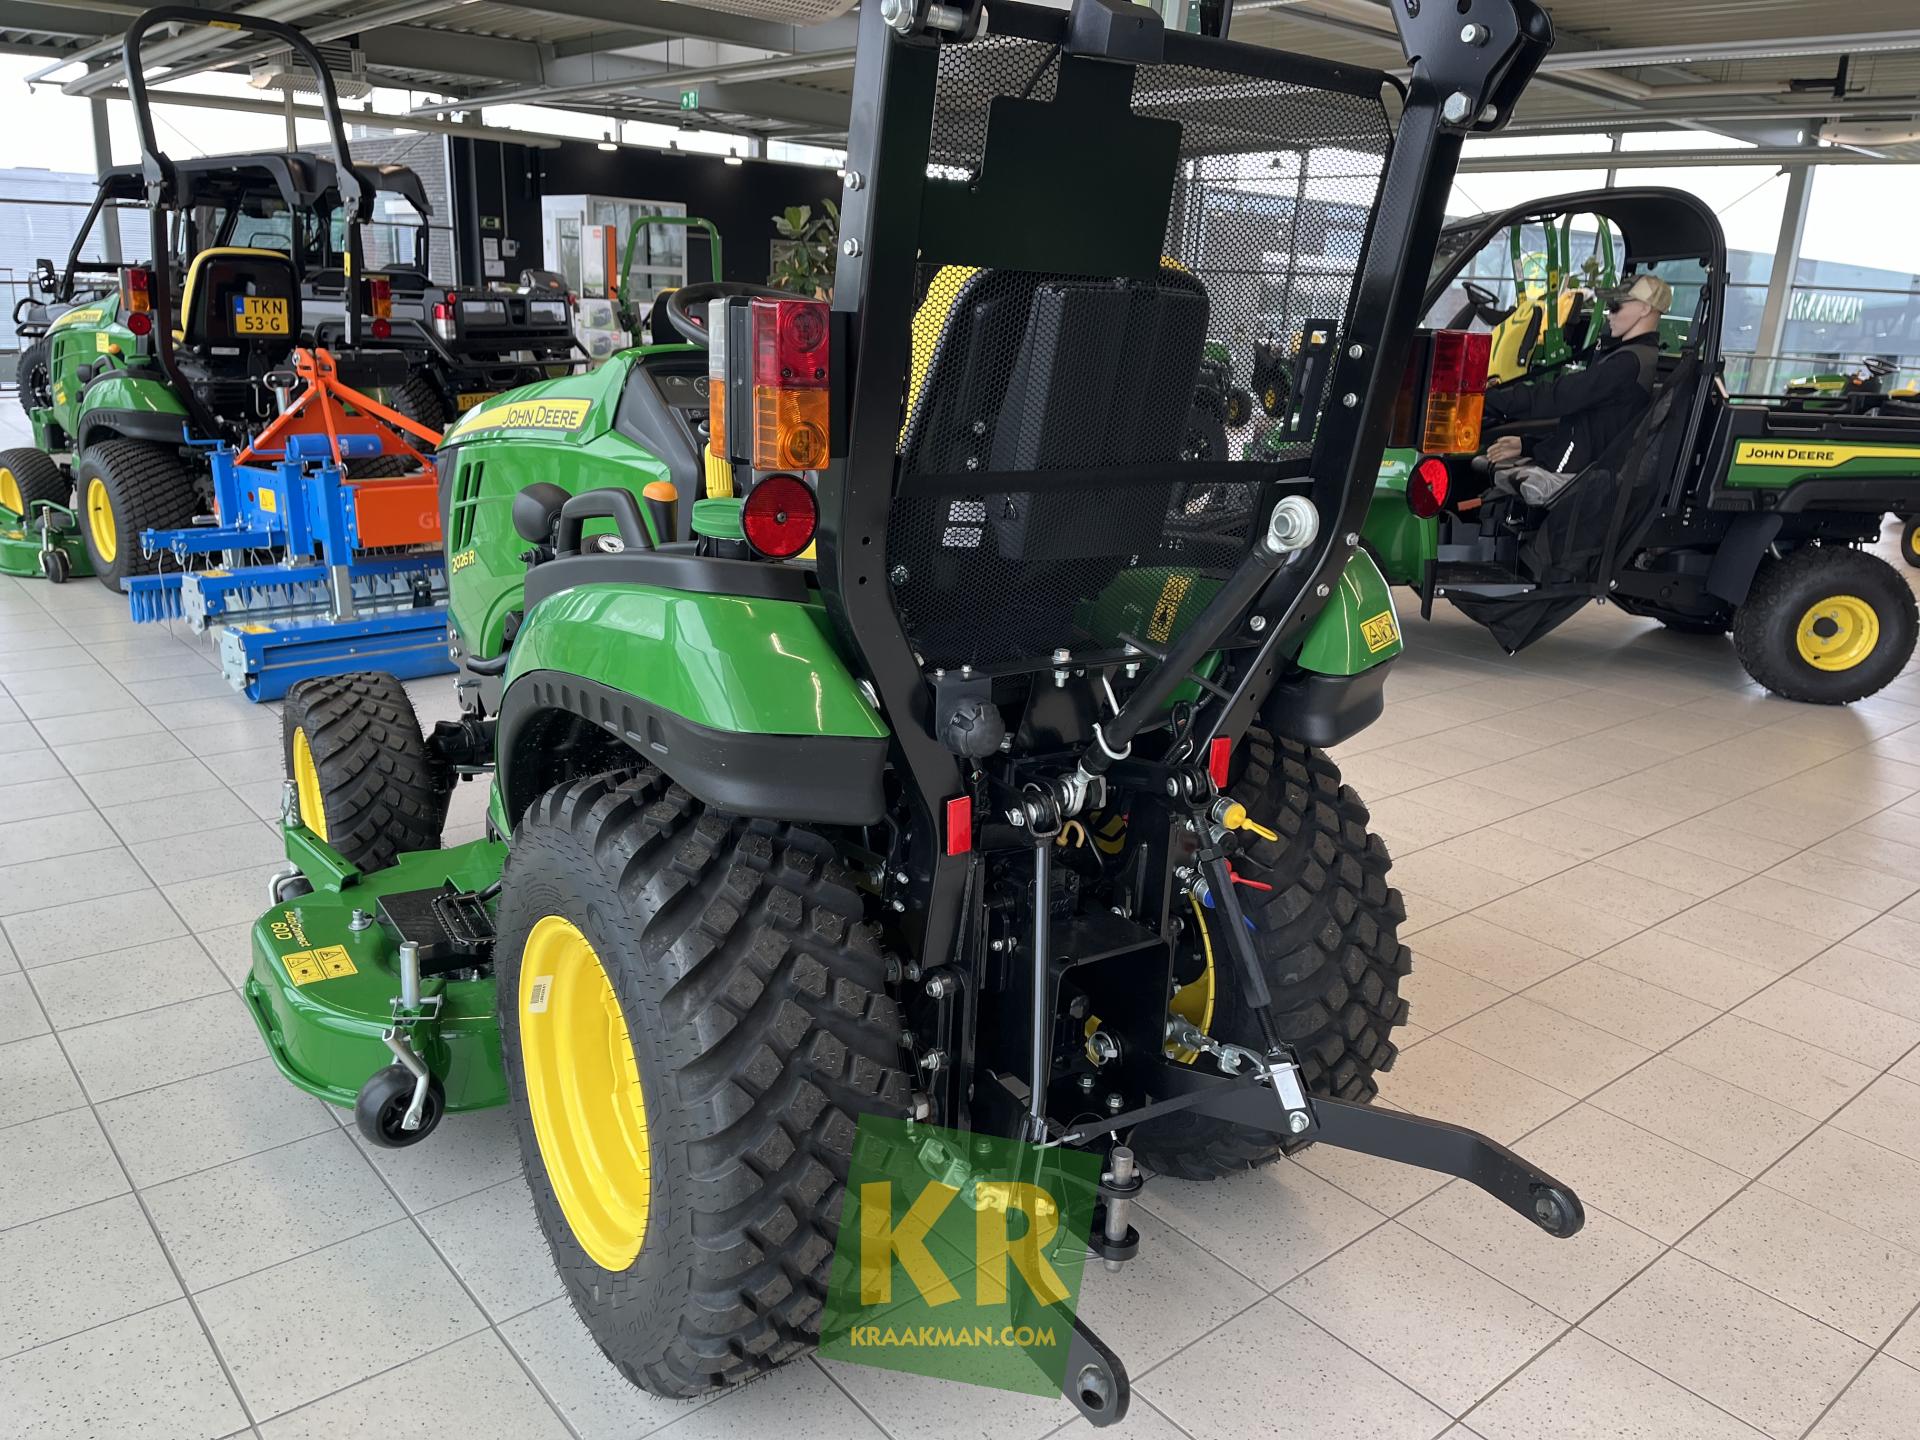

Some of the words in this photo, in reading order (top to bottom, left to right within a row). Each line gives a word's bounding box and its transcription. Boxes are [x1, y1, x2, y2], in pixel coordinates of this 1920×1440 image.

[251, 299, 282, 315] TKN
[502, 407, 535, 425] JOHN
[535, 405, 579, 426] DEERE
[1746, 447, 1784, 459] JOHN
[1787, 448, 1835, 461] DEERE
[270, 922, 293, 940] 60D
[283, 910, 313, 948] AutoConnect
